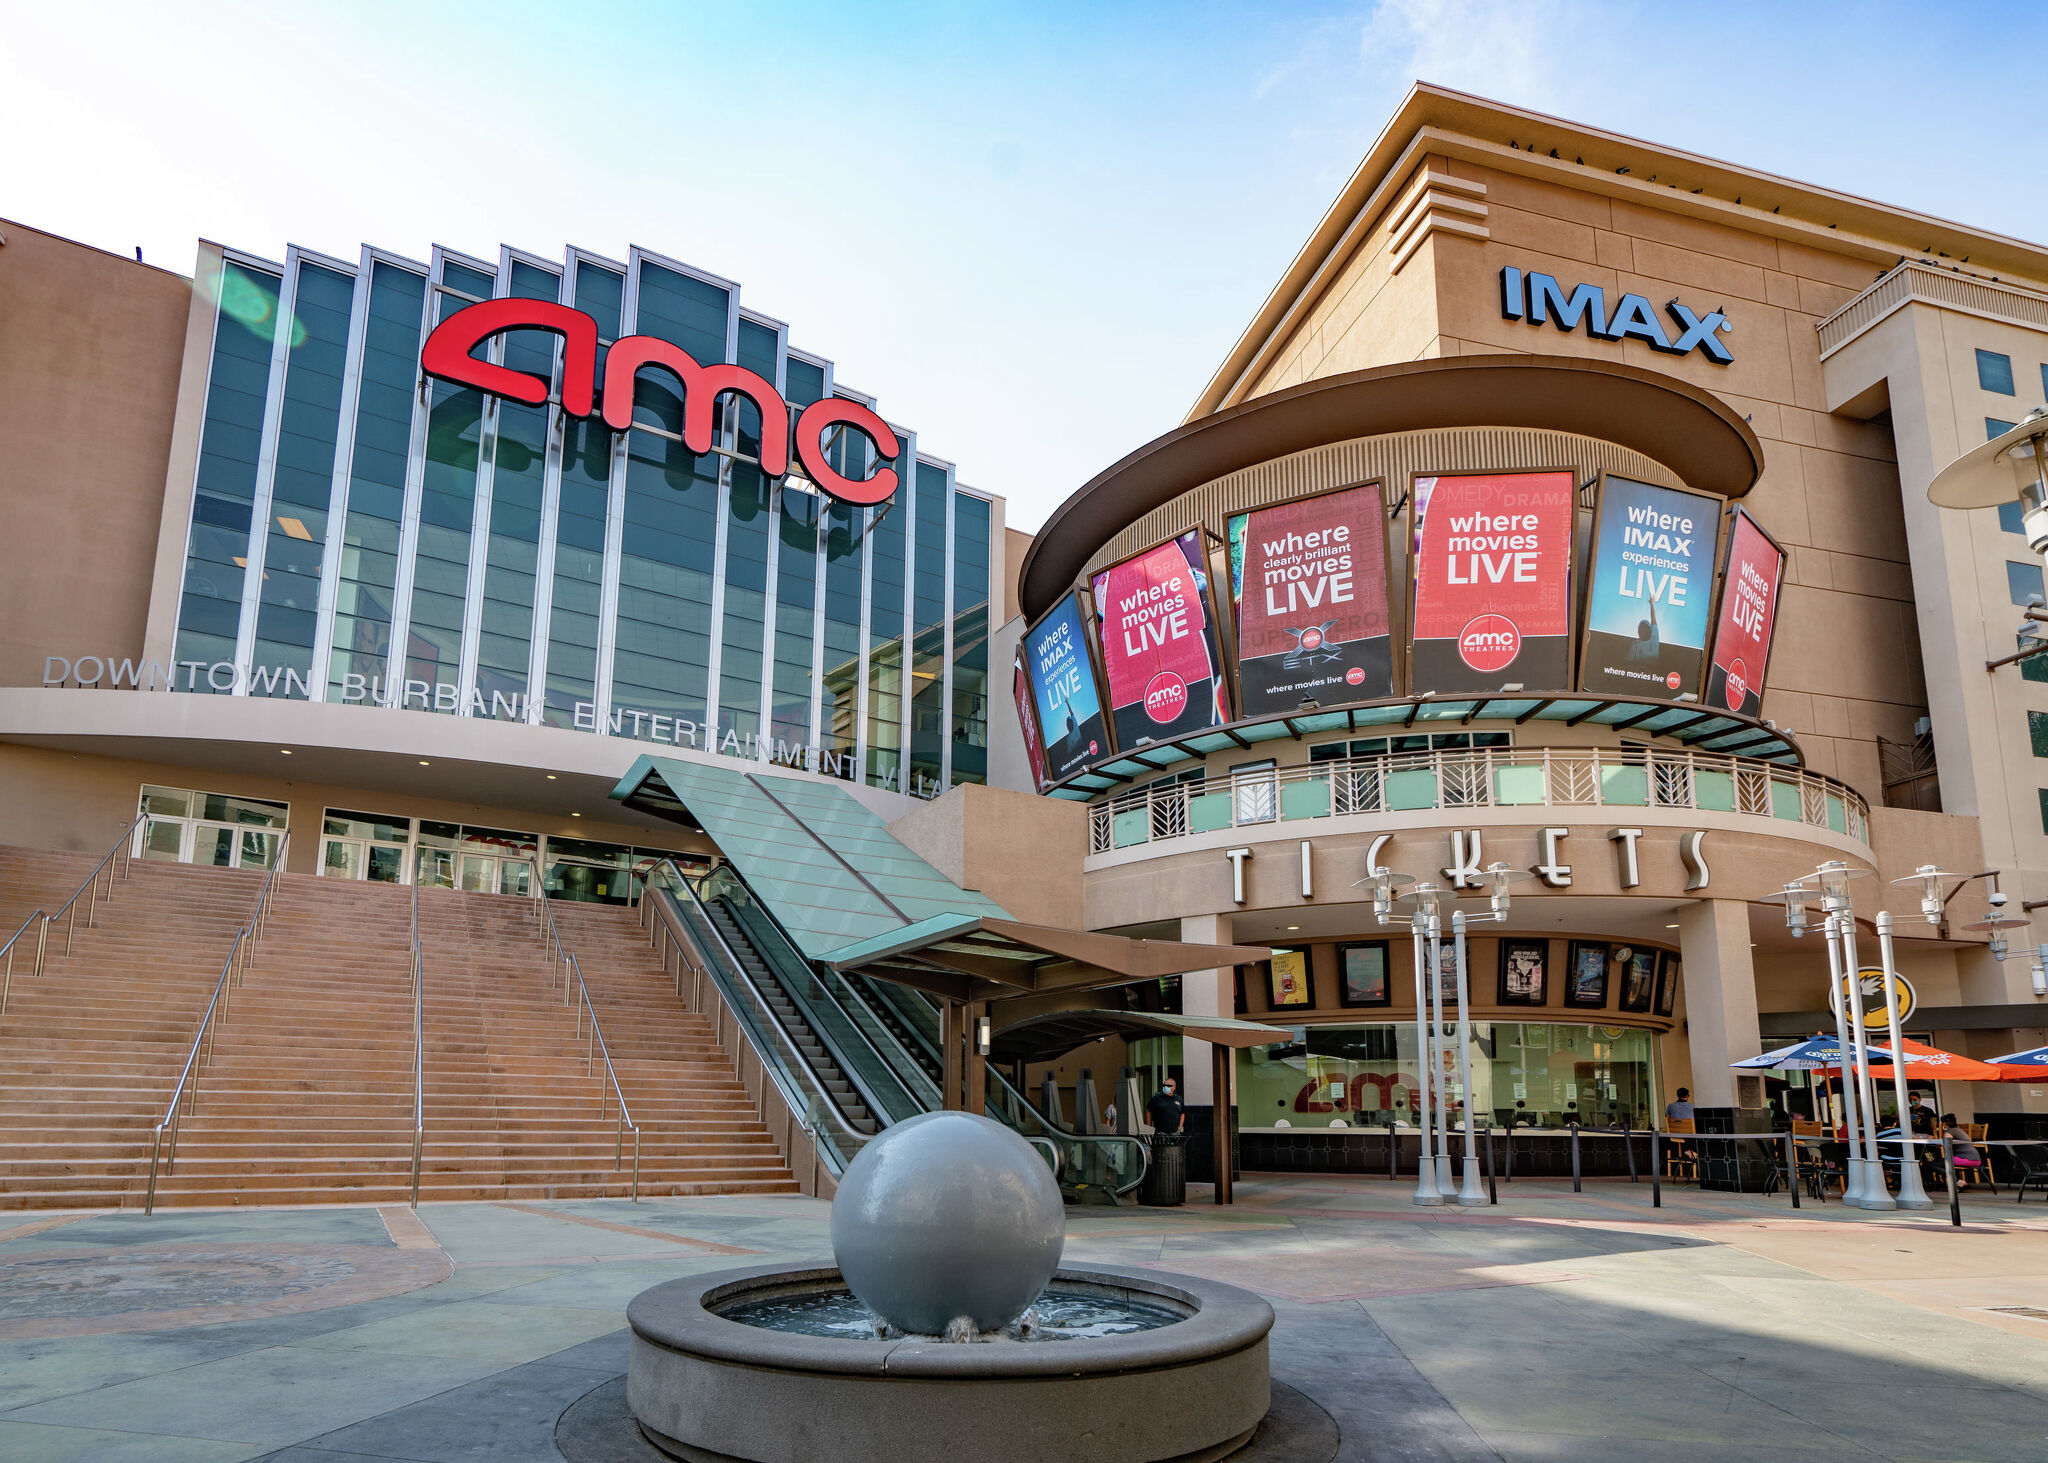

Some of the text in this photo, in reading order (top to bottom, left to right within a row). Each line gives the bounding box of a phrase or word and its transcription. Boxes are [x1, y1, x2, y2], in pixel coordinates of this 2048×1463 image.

[1500, 265, 1735, 366] IMAX
[421, 297, 900, 506] amc
[1433, 485, 1505, 502] OMEDY
[1450, 511, 1539, 533] where
[1628, 505, 1693, 535] where
[1263, 525, 1350, 557] where
[1263, 542, 1352, 569] clearly brilliant
[1448, 534, 1538, 551] movies
[1624, 526, 1692, 557] IMAX
[1264, 554, 1353, 585] movies
[1447, 552, 1537, 585] LIVE
[1622, 550, 1689, 572] experiences
[1266, 571, 1354, 616] LIVE
[1618, 566, 1689, 607] LIVE
[1742, 559, 1768, 597] where
[1119, 576, 1182, 613] where
[1738, 577, 1766, 614] movies
[1122, 593, 1185, 630] movies
[1732, 596, 1764, 642] LIVE
[1038, 620, 1068, 657] where
[1123, 609, 1189, 657] LIVE
[1464, 632, 1513, 646] amc
[1041, 637, 1073, 674] IMAX
[1044, 655, 1076, 684] experiences
[1283, 650, 1344, 670] ETX
[1047, 666, 1082, 711] LIVE
[1266, 675, 1343, 694] where movies live
[1604, 666, 1664, 683] where movies live
[1728, 672, 1745, 691] amc
[1148, 695, 1183, 710] THEATRES
[1149, 683, 1182, 705] amc
[43, 655, 957, 800] DOWNTOWN BURBANK ENTERTAINMENT VILLA
[1226, 828, 1709, 906] TICKETS
[1568, 1039, 1573, 1048] 3
